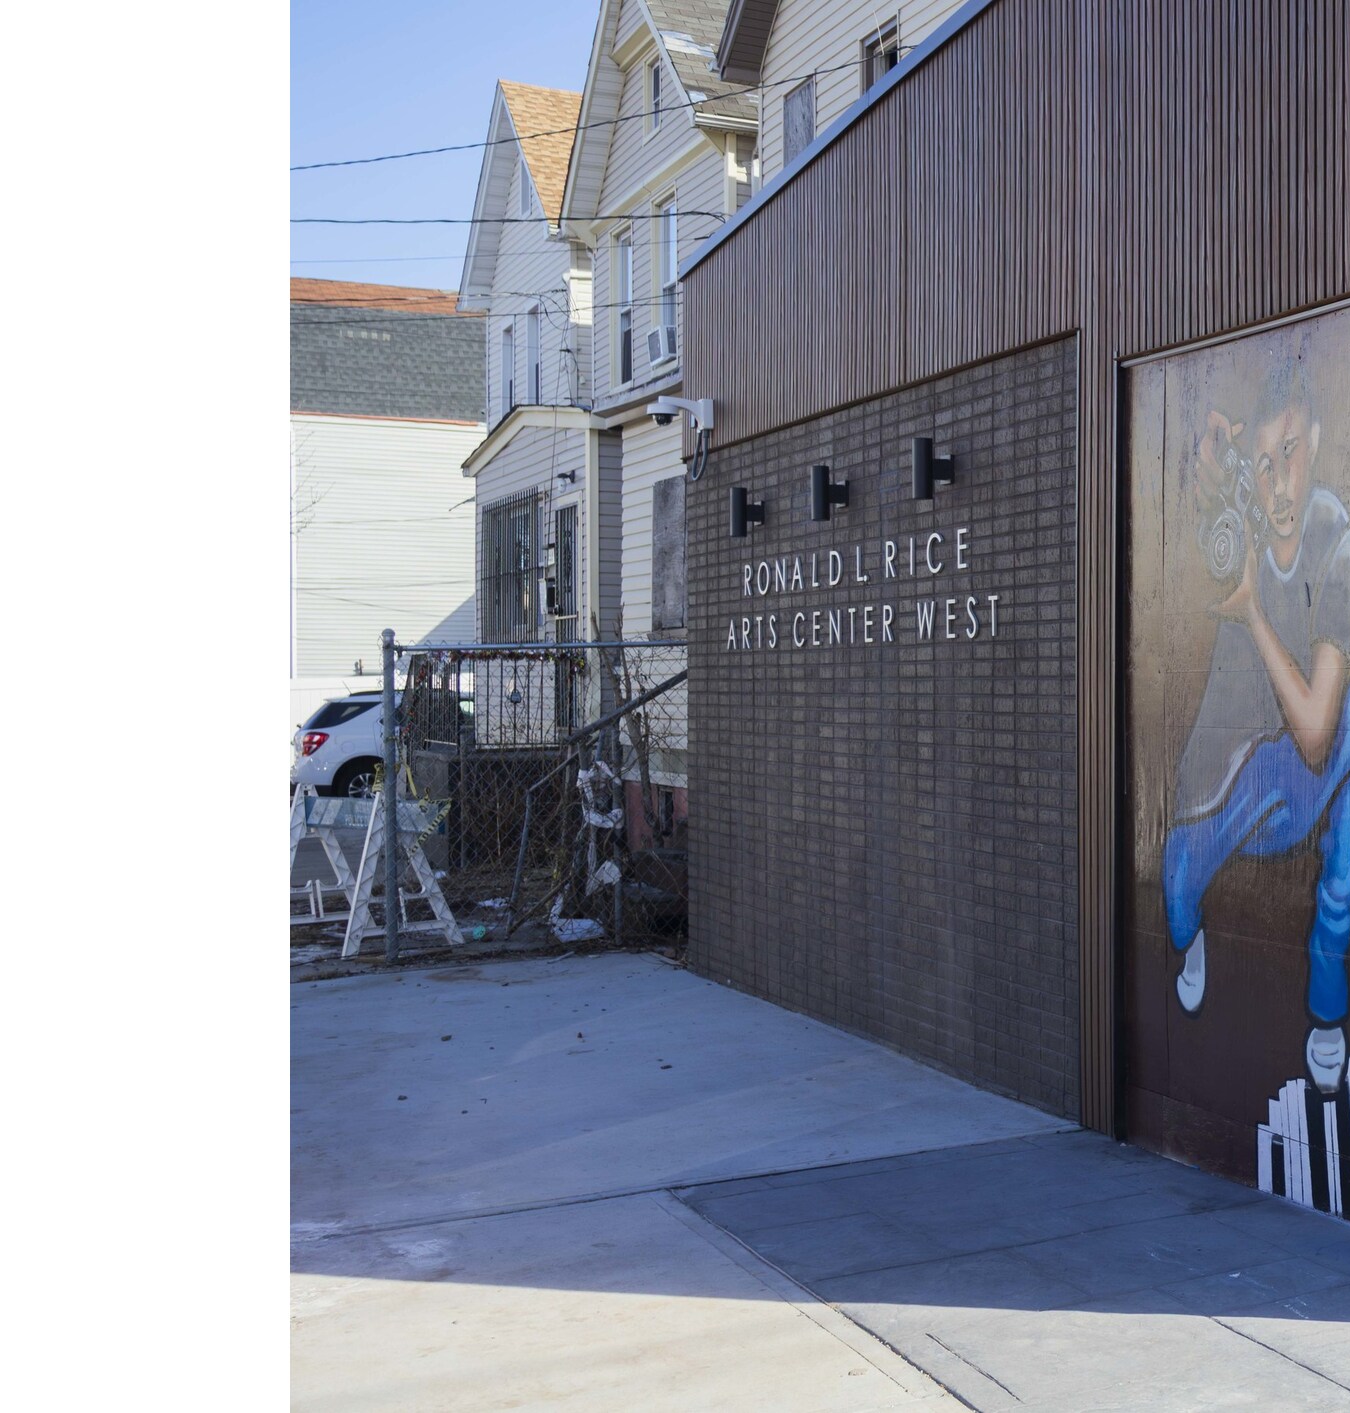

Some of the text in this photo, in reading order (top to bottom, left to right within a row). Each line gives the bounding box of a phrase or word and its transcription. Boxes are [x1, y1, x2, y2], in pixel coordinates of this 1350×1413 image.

[744, 528, 968, 596] RONALD L. RICE
[727, 595, 998, 650] ARTS CENTER WEST
